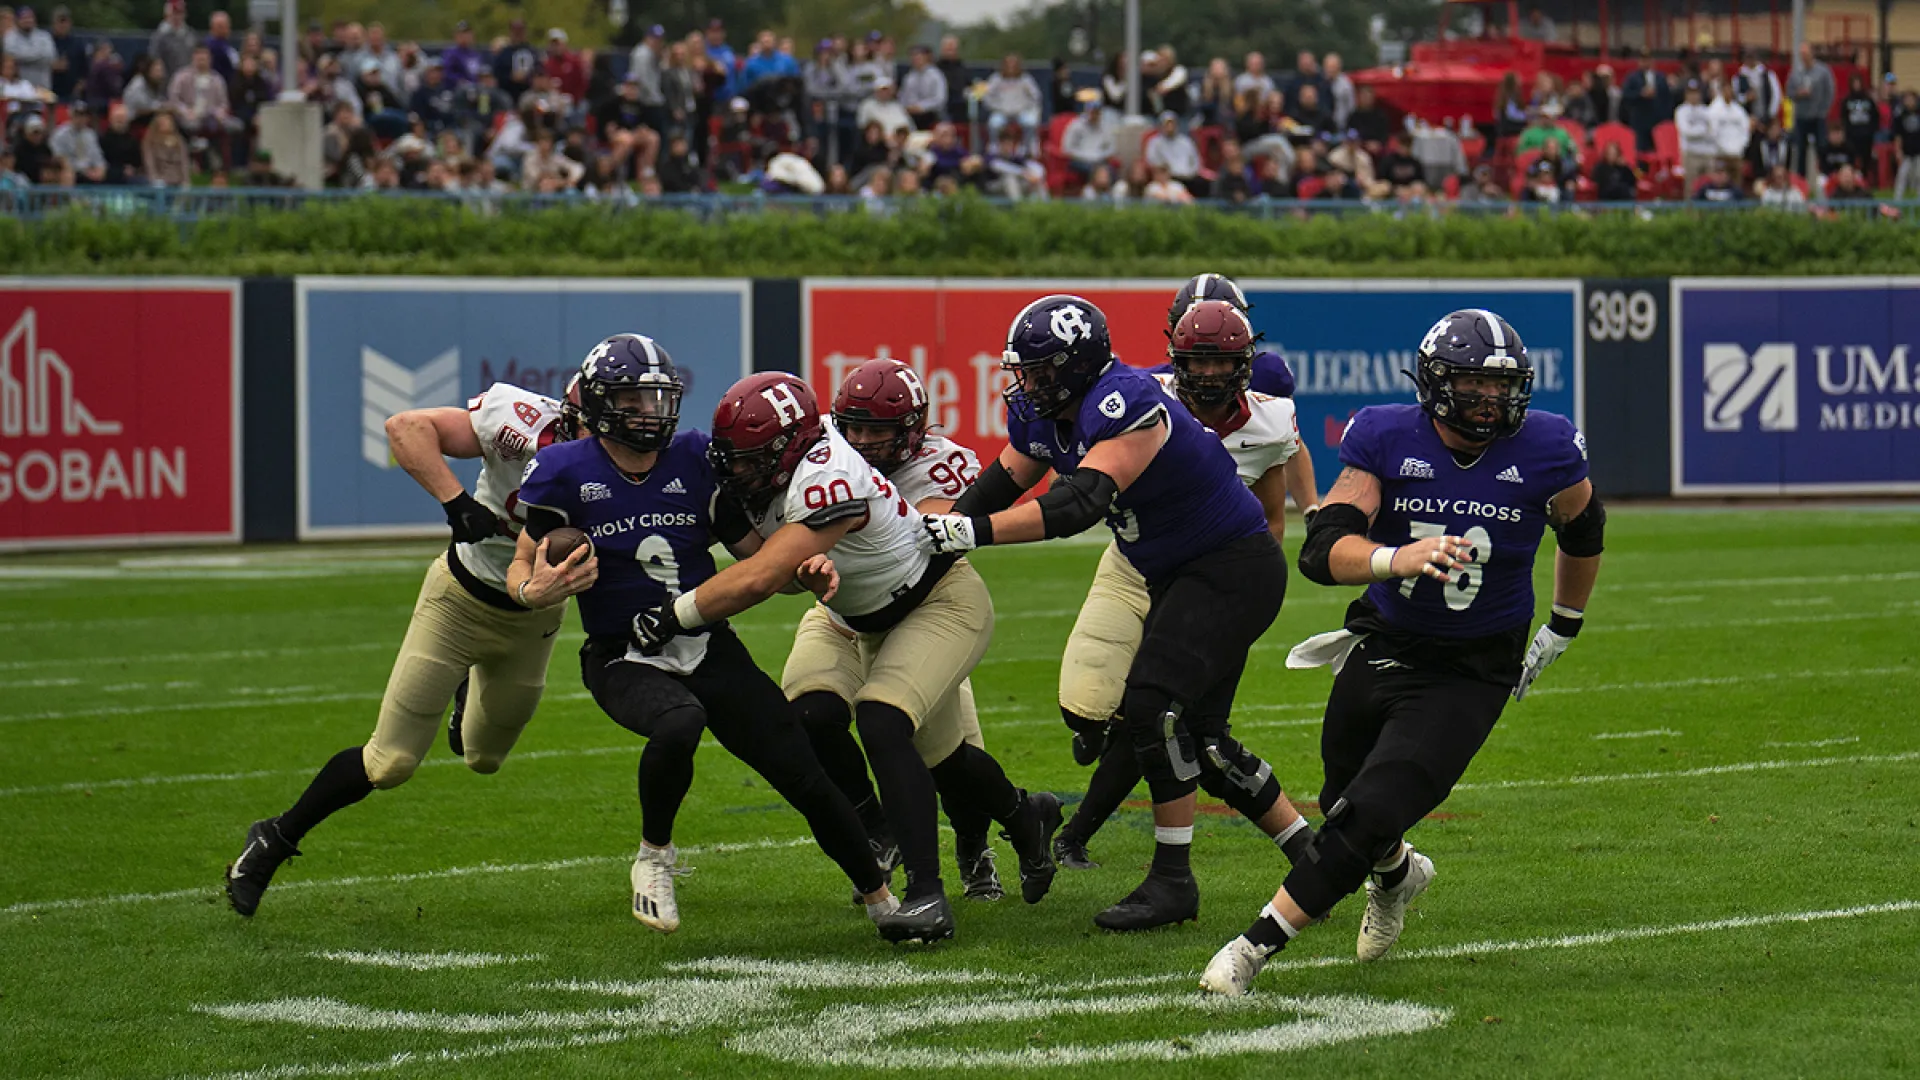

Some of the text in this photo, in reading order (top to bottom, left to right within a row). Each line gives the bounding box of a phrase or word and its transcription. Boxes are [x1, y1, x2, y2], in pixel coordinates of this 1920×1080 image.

[1588, 291, 1657, 341] 399
[896, 368, 927, 407] H
[1812, 344, 1920, 396] UM
[761, 382, 806, 428] H
[804, 479, 854, 509] 90
[928, 451, 977, 496] 92
[590, 512, 697, 538] HOLY CROSS
[1393, 497, 1522, 523] HOLY CROSS
[1398, 520, 1493, 611] 78
